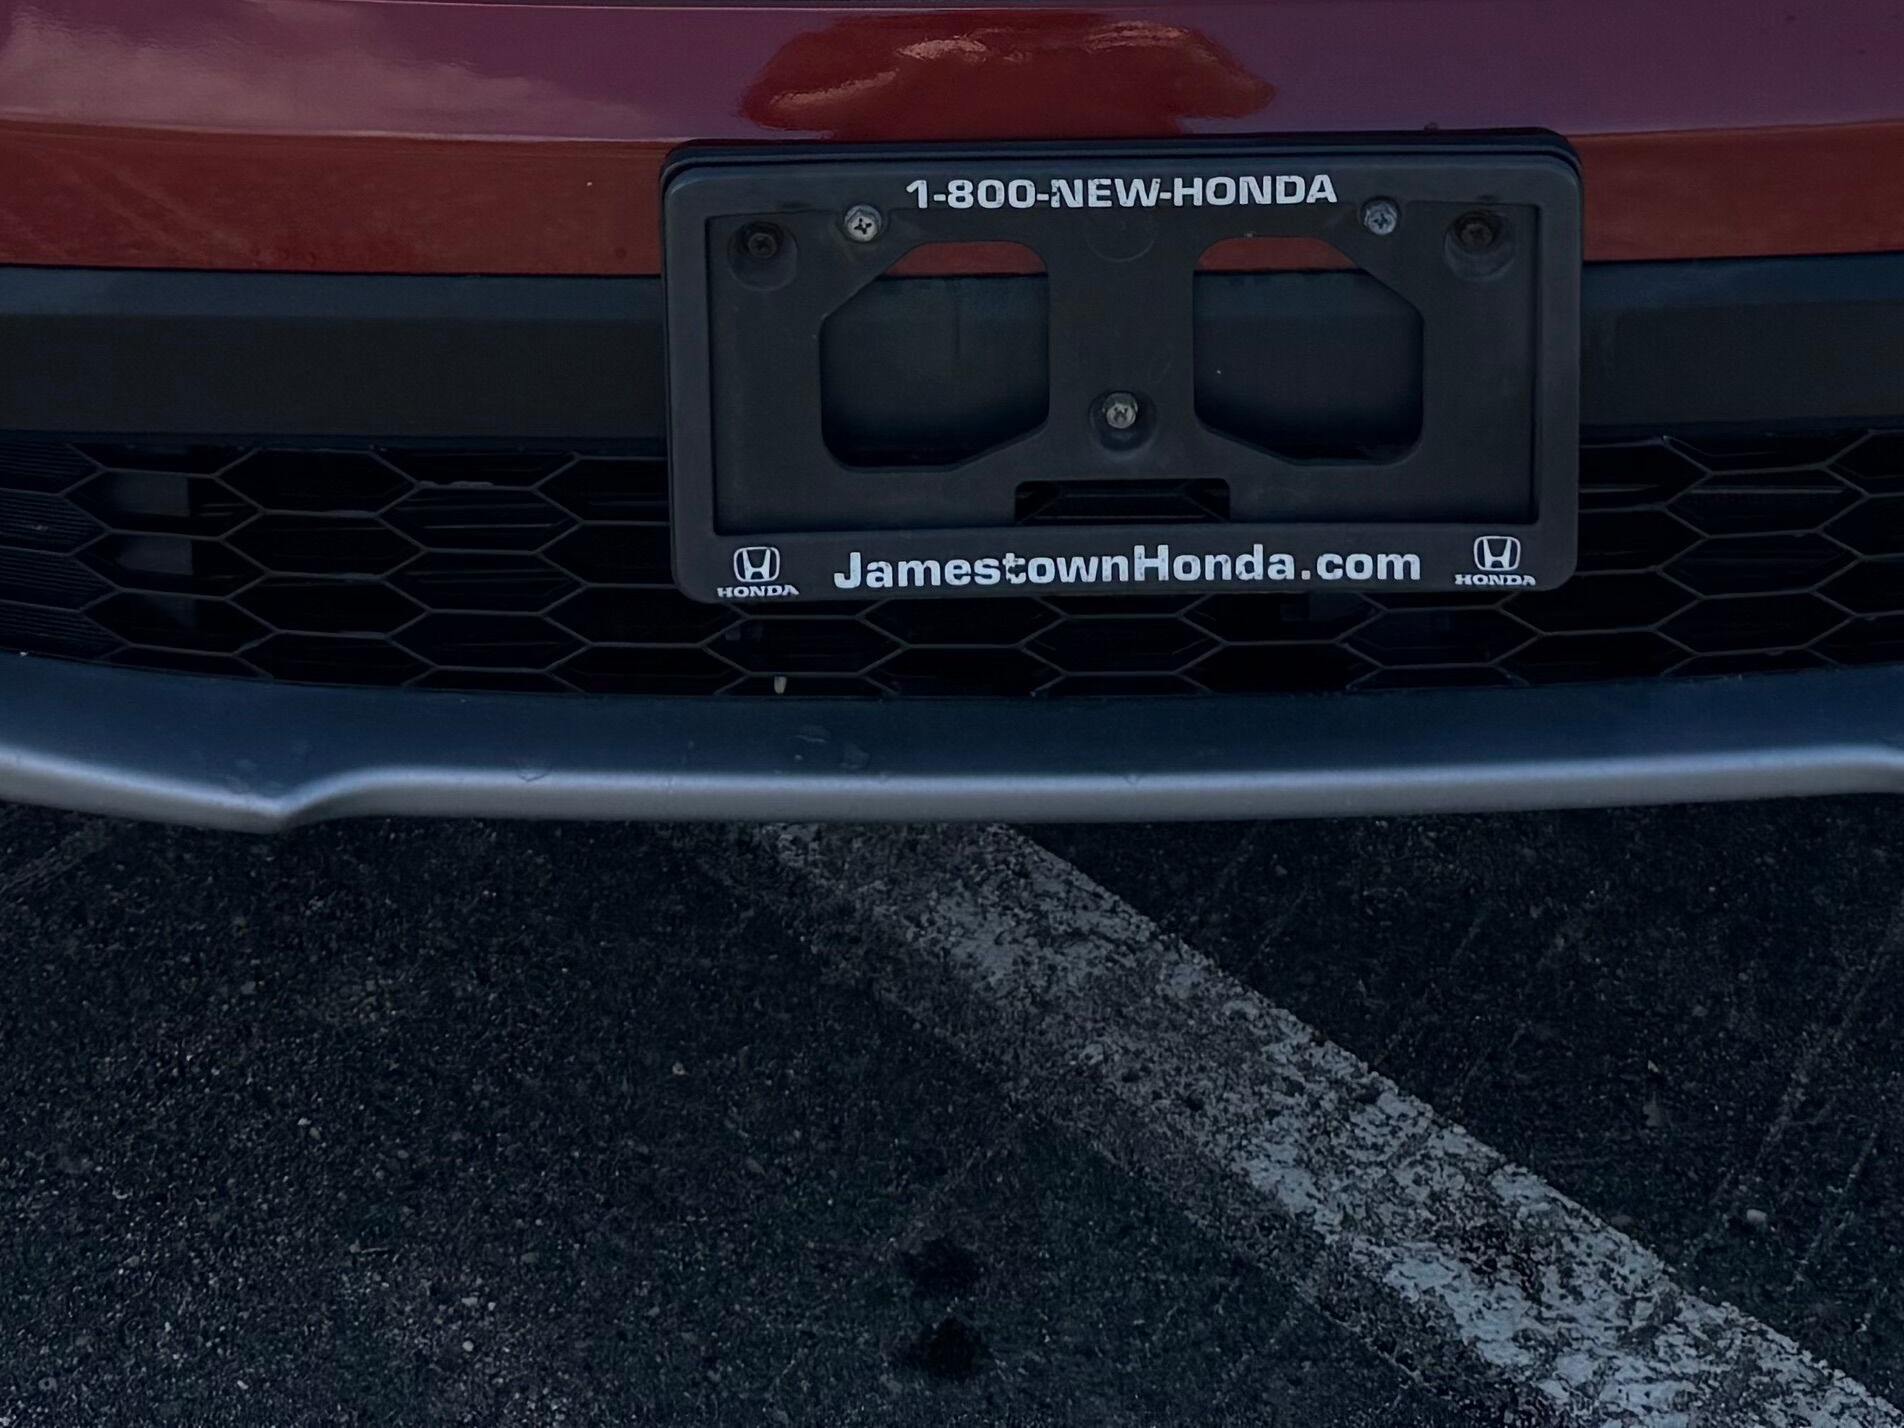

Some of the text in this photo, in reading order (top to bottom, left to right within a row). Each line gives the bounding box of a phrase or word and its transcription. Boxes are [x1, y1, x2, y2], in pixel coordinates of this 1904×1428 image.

[905, 174, 1338, 209] 1-800-NEW-HONDA
[833, 543, 1421, 589] JamestownHonda.com
[716, 584, 800, 598] HONDA
[1454, 574, 1536, 586] HONDA
